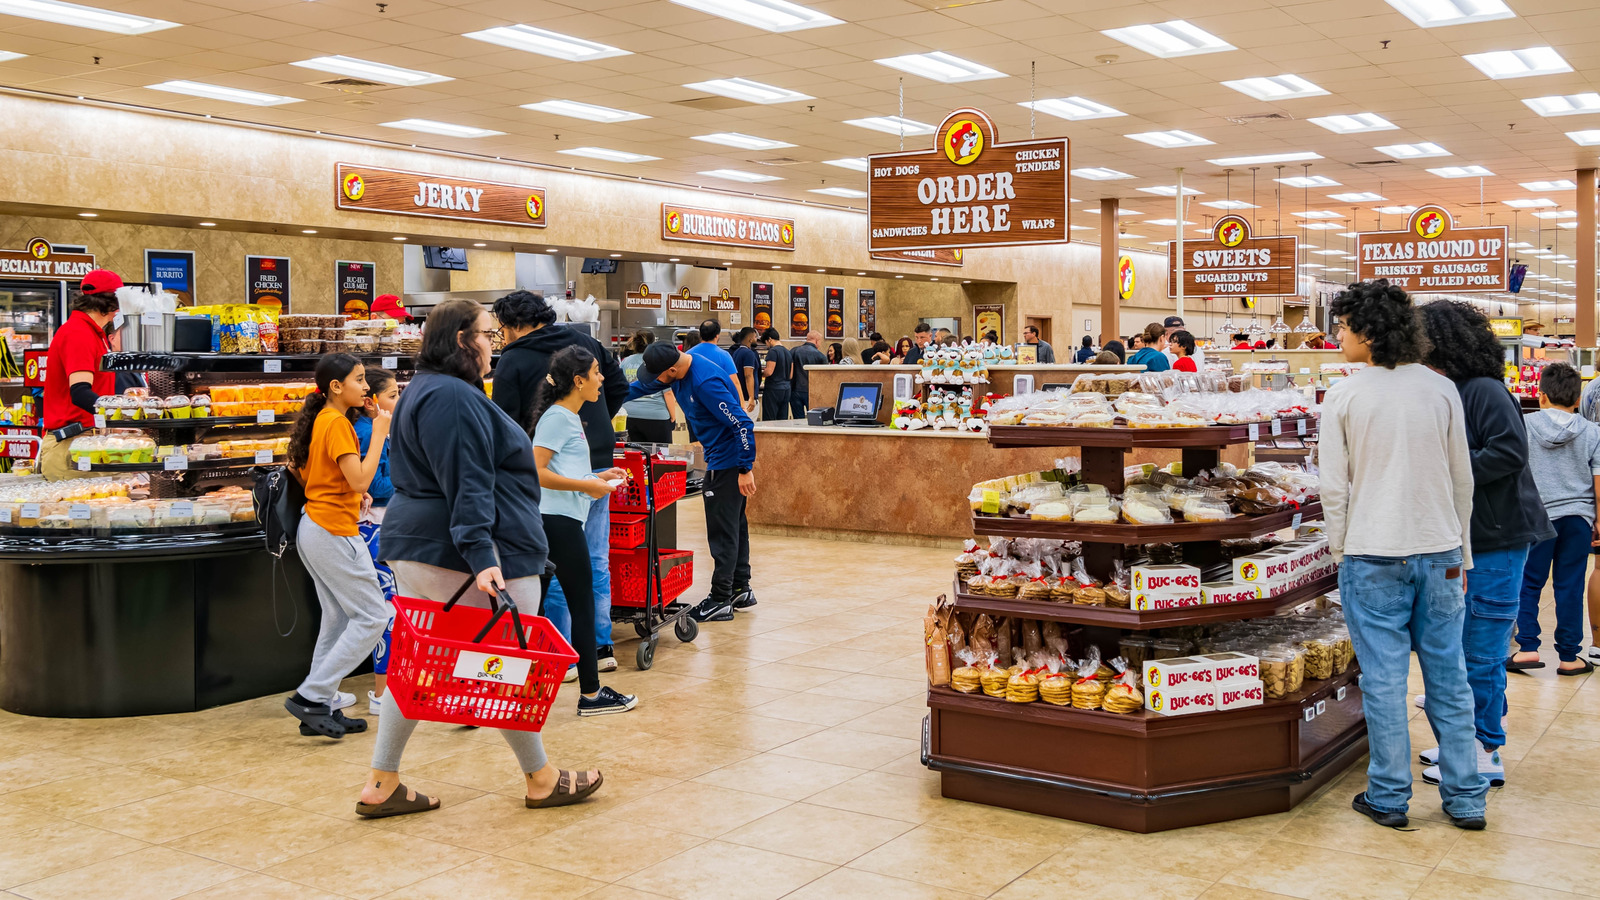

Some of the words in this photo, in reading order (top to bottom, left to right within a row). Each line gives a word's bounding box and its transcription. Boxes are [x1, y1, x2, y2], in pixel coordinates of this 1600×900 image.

[1015, 148, 1060, 161] CHICKEN
[874, 167, 893, 177] HOT
[895, 165, 920, 176] DOGS
[1015, 160, 1061, 173] TENDERS
[917, 171, 1016, 205] ORDER
[413, 181, 484, 213] JERKY
[930, 203, 1012, 235] HERE
[1021, 219, 1055, 230] WRAPS
[682, 212, 737, 239] BURRITOS
[738, 219, 747, 239] &
[748, 219, 780, 243] TACOS
[872, 226, 928, 238] SANDWICHES
[1362, 242, 1414, 262] TEXAS
[1416, 240, 1474, 259] ROUND
[1477, 238, 1502, 257] UP
[1192, 248, 1271, 268] SWEETS
[0, 259, 52, 274] ECIALTY
[54, 261, 93, 275] MEATS
[1374, 265, 1424, 276] BRISKET
[1432, 263, 1488, 274] SAUSAGE
[156, 271, 184, 279] BURRITO
[260, 274, 278, 282] FRIED
[1194, 273, 1239, 284] SUGARED
[1241, 272, 1268, 283] NUTS
[1362, 277, 1410, 287] TKEY
[1419, 276, 1464, 287] PULLED
[1466, 275, 1500, 286] PORK
[254, 281, 283, 289] CHICKEN
[1214, 282, 1248, 293] FUDGE
[671, 299, 701, 309] BURRITOS
[716, 300, 734, 309] TACOS
[740, 427, 750, 451] CREW
[1147, 574, 1199, 590] BUC-EE'S
[1168, 669, 1212, 687] BUC-EE'S
[1216, 663, 1258, 681] BUC-EE'S
[1170, 693, 1215, 711] BUC-EE'S
[1222, 687, 1262, 705] BUC-EE'S
